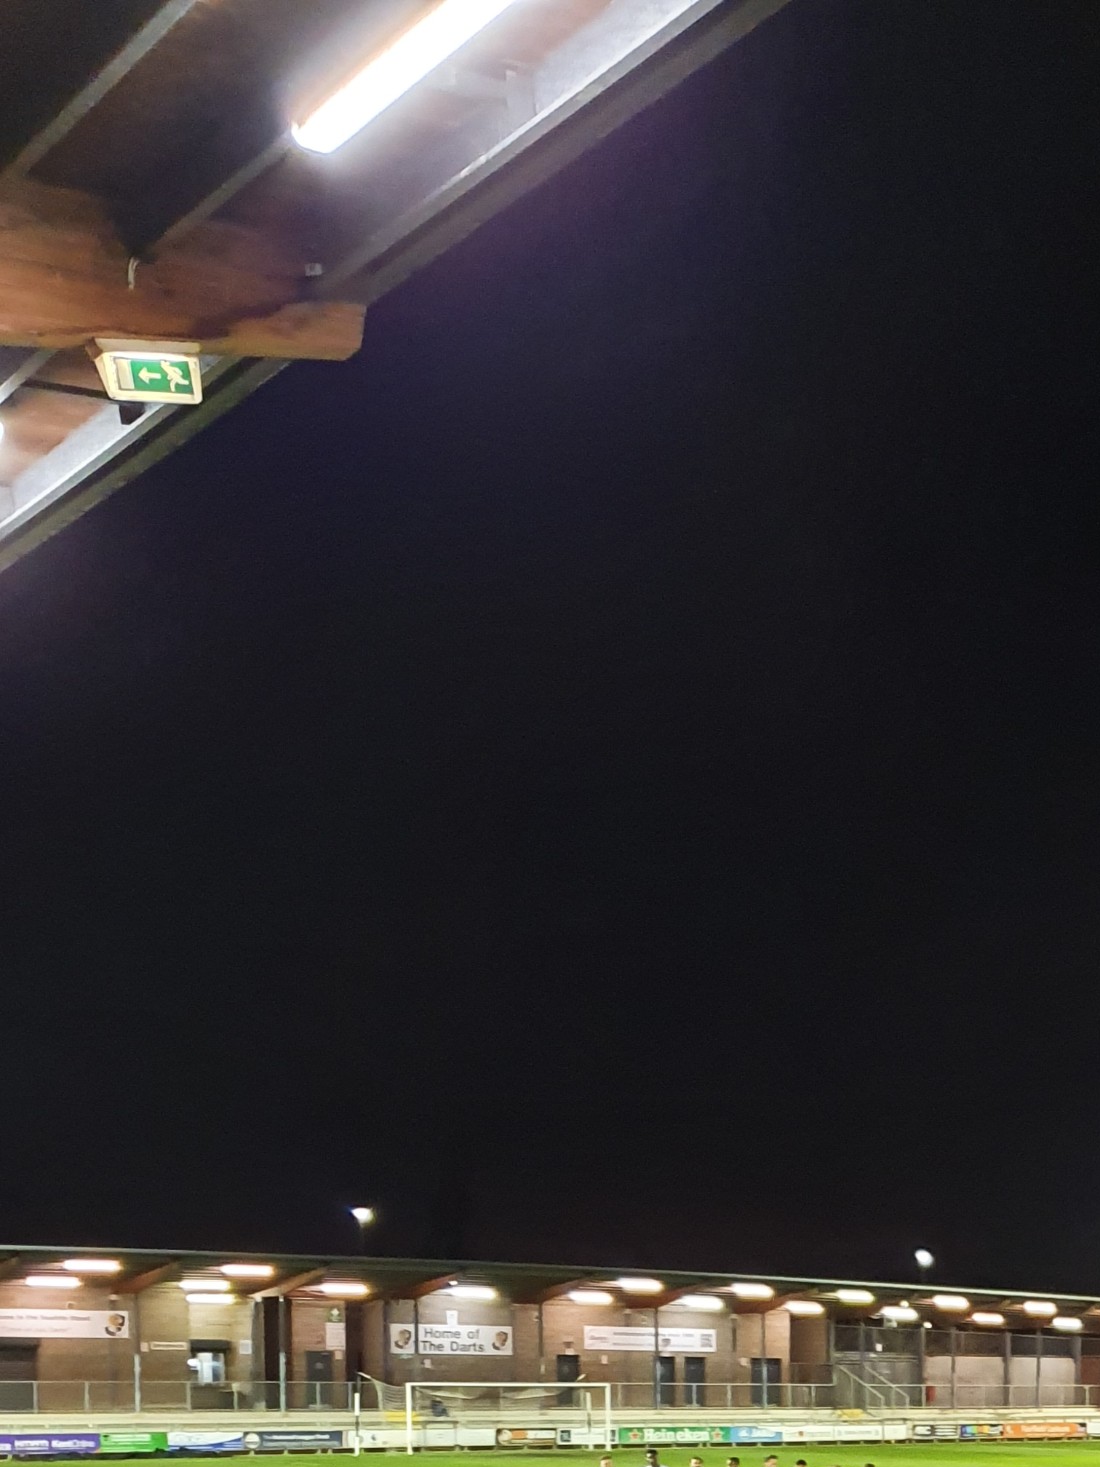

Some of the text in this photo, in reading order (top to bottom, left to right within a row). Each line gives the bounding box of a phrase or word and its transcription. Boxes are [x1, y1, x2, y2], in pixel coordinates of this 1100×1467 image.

[424, 1328, 480, 1339] Home of
[420, 1341, 484, 1352] The Darts
[643, 1427, 711, 1442] Heineken
